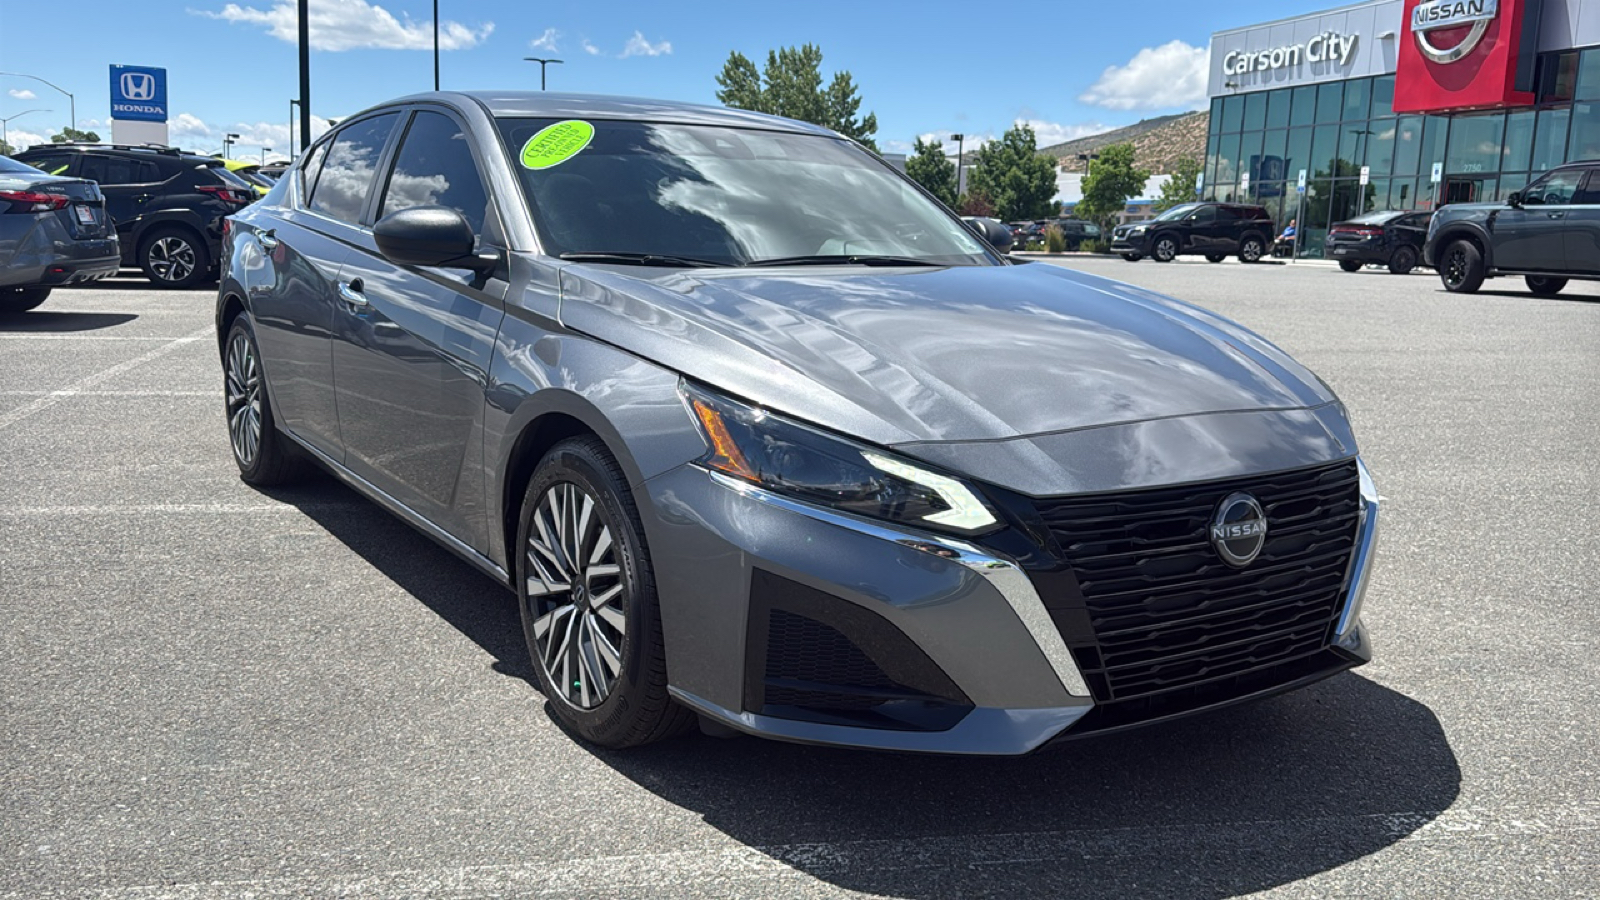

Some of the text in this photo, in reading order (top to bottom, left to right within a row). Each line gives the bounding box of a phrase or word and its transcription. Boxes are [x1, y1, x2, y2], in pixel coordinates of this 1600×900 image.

[1415, 0, 1484, 25] NISSAN
[1223, 29, 1359, 76] Carson City
[113, 104, 165, 115] HONDA
[1463, 163, 1482, 173] 2750
[1213, 522, 1267, 539] NISSAN
